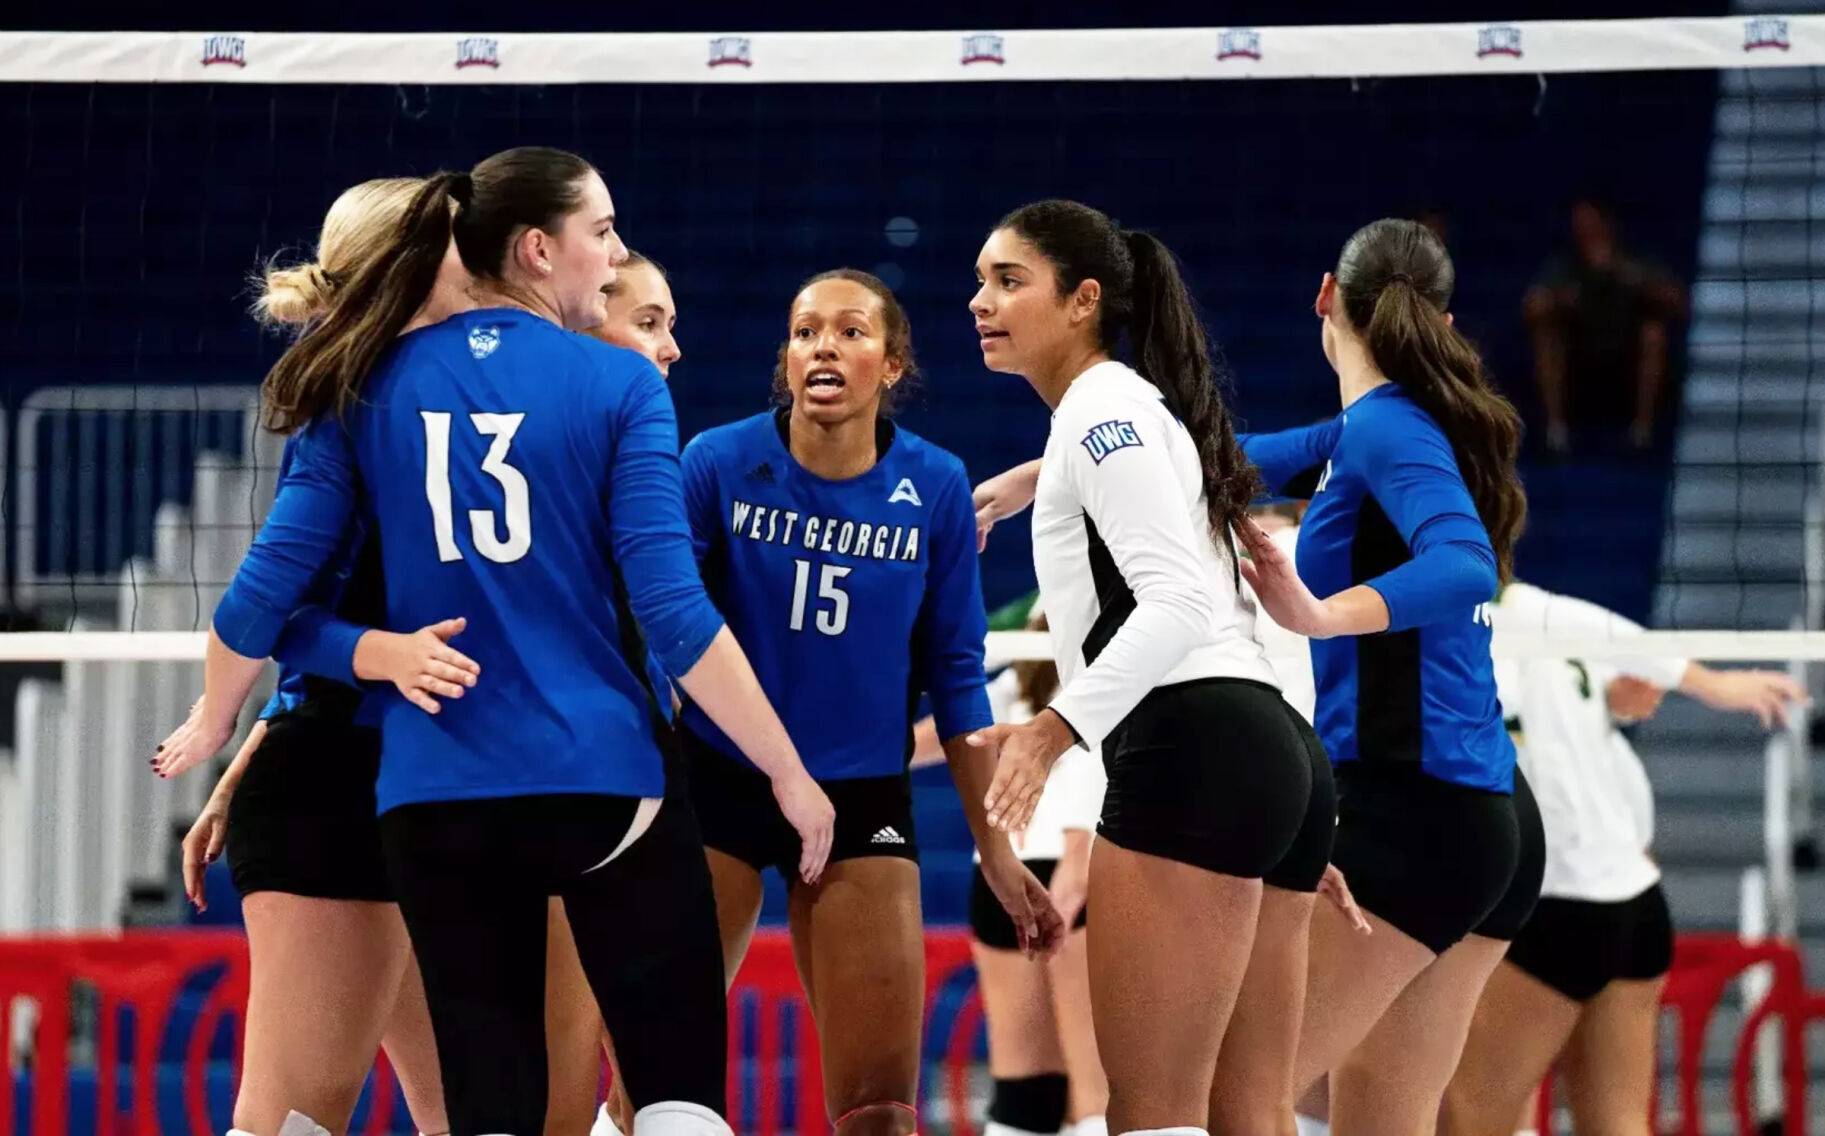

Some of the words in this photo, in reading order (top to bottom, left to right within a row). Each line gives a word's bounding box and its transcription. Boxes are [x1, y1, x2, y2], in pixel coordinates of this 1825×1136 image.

[1080, 419, 1144, 466] UWG
[419, 410, 532, 564] 13
[732, 500, 799, 546] WEST
[803, 515, 920, 561] GEORGIA
[789, 558, 853, 636] 15
